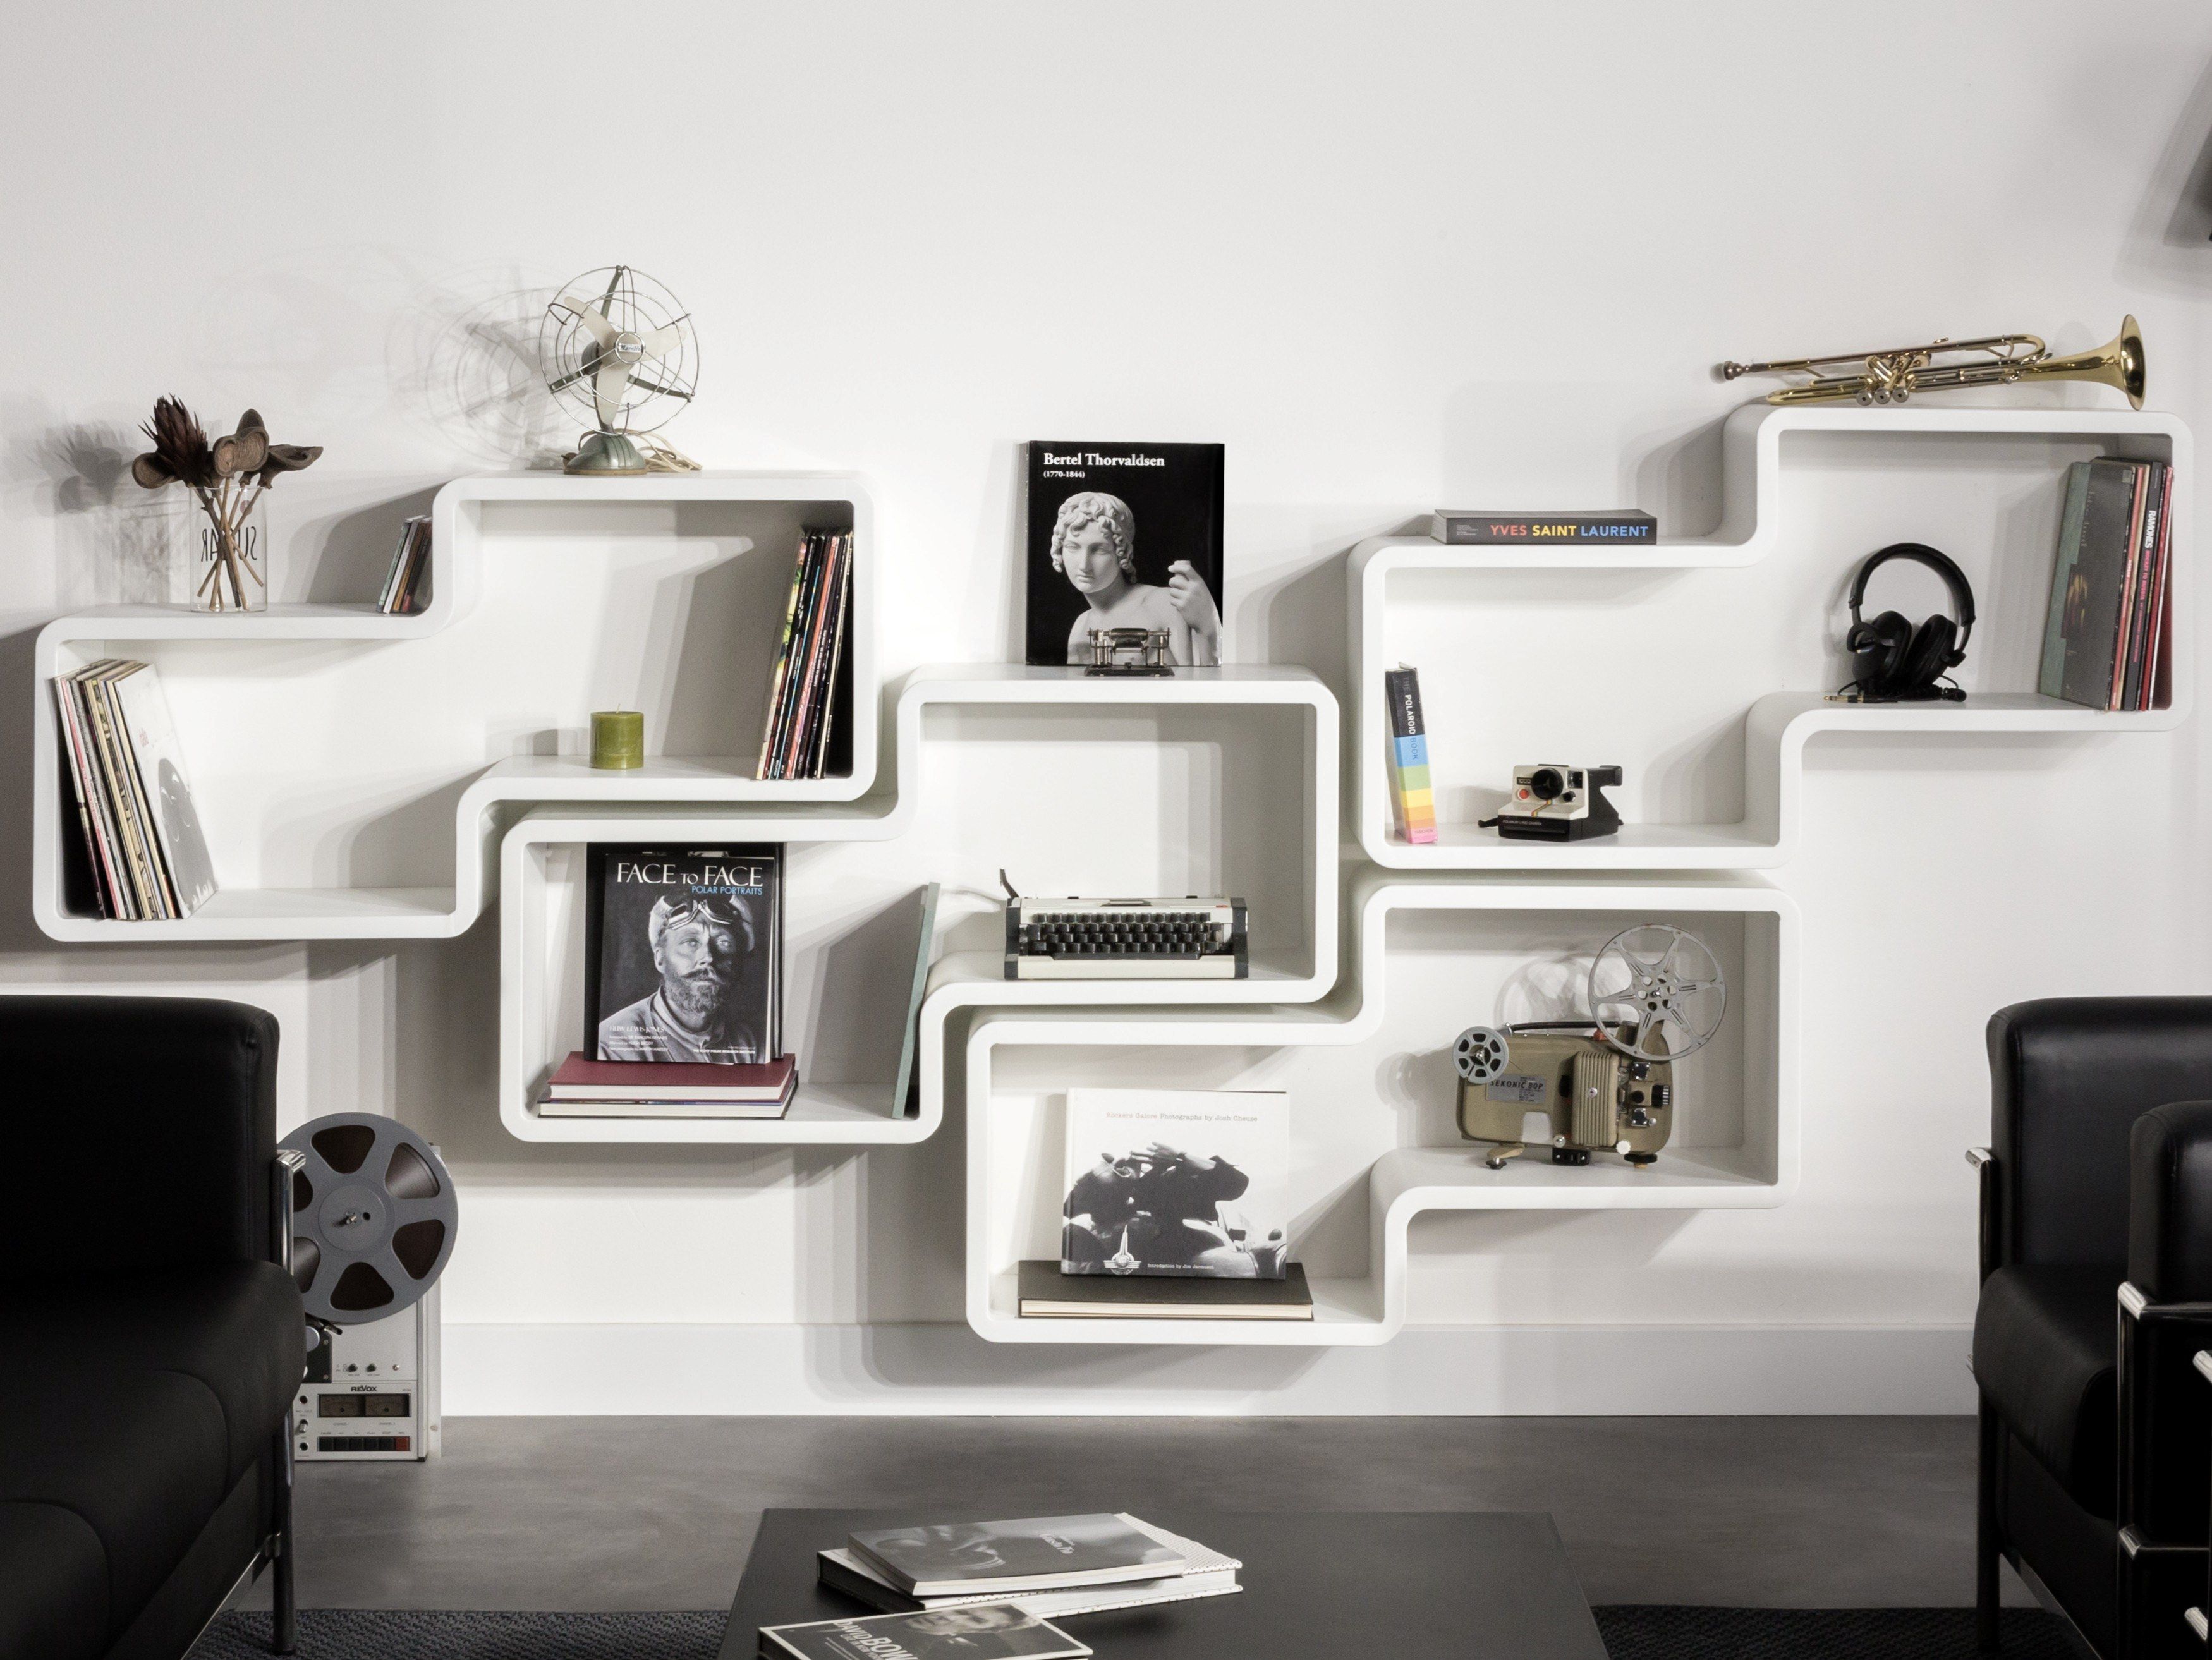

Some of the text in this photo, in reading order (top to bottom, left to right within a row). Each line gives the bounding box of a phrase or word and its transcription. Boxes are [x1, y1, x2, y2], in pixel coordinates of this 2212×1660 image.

[1043, 452, 1165, 466] Bertel Thorvaldsen
[1490, 524, 1527, 536] YVES
[1532, 524, 1577, 536] SAINT
[1581, 525, 1648, 537] LAURENT
[2144, 511, 2157, 548] RAMONES
[1405, 694, 1416, 735] POLAROID
[1410, 737, 1419, 759] BOOK
[617, 863, 676, 884] FACE
[704, 865, 763, 887] FACE
[692, 885, 763, 895] POLAR PORTRAITS
[1490, 1080, 1526, 1089] SEKONIC
[1160, 1113, 1202, 1121] Photographs
[834, 1621, 872, 1640] DAVID
